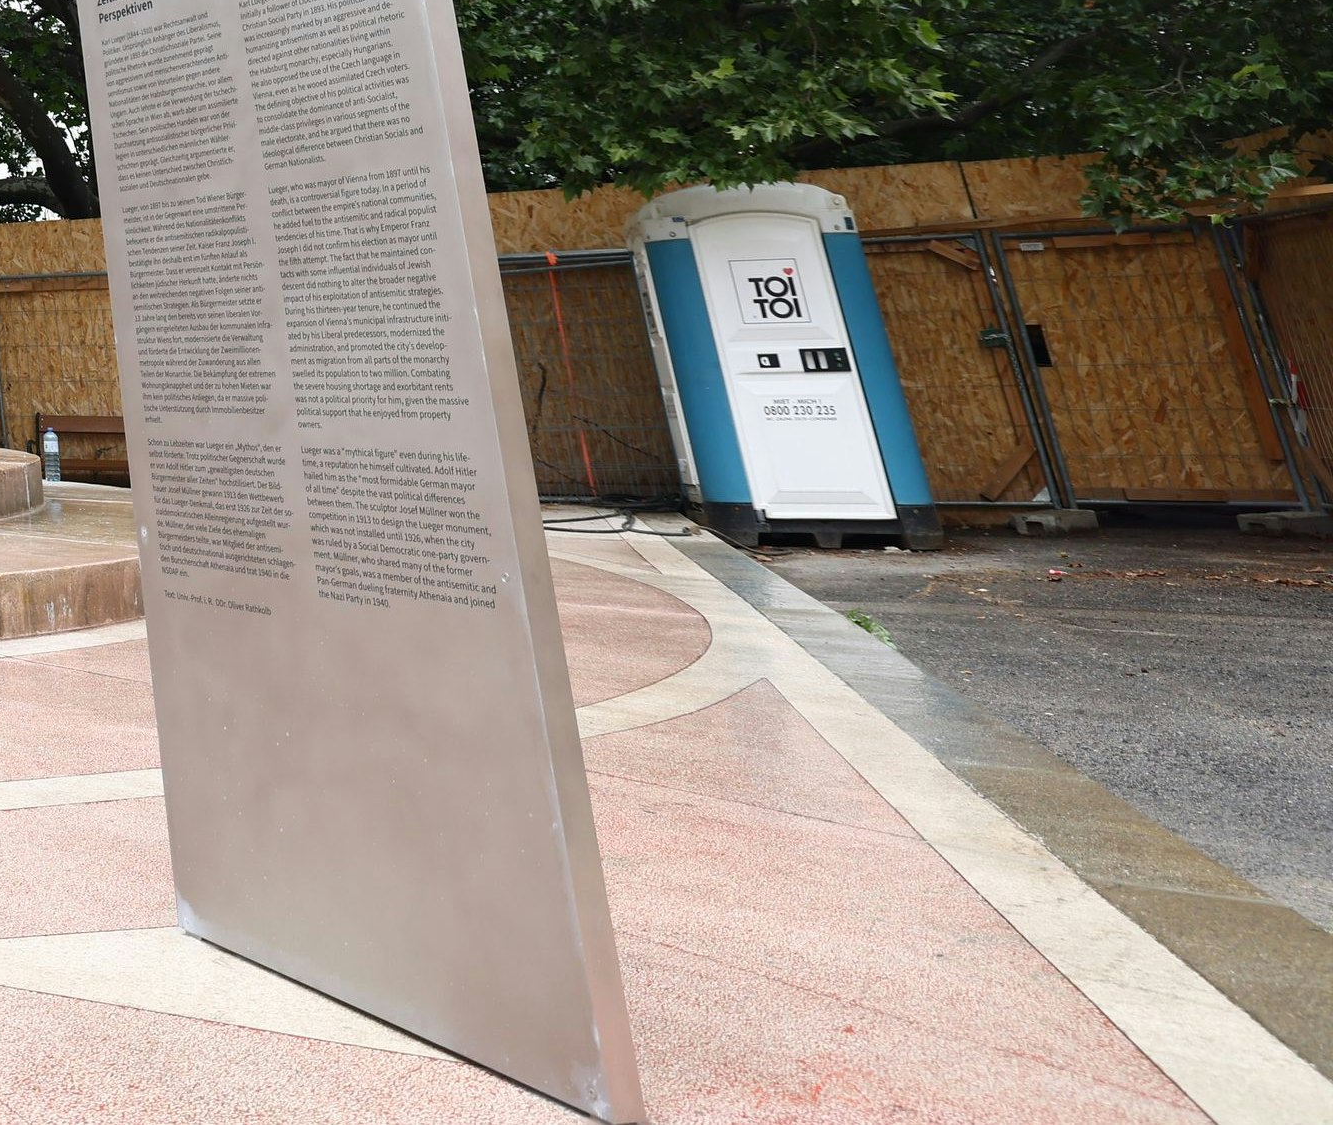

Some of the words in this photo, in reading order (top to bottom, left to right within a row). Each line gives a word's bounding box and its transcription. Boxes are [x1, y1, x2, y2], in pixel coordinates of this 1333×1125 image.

[98, 0, 154, 24] Perspektiven
[239, 0, 250, 8] Karl
[240, 9, 261, 20] Initially
[266, 2, 290, 13] follower
[242, 20, 267, 31] Christian
[267, 13, 286, 25] Social
[286, 11, 302, 20] Party
[302, 8, 310, 17] in
[327, 0, 338, 10] His
[264, 160, 288, 171] German
[753, 297, 802, 319] TOI
[764, 405, 790, 416] 0800
[794, 405, 813, 416] 230
[816, 405, 836, 416] 235
[301, 446, 322, 455] Lueger
[417, 451, 443, 462] during
[443, 451, 455, 462] his
[325, 461, 359, 470] reputation
[359, 461, 368, 470] he
[369, 462, 394, 472] himself
[434, 465, 454, 475] Adolf
[455, 467, 477, 477] Hitler
[304, 471, 323, 480] hailed
[324, 472, 337, 481] him
[346, 474, 357, 483] the
[380, 475, 418, 487] formidable
[420, 478, 450, 489] German
[451, 480, 475, 492] mayor
[306, 484, 312, 493] of
[313, 485, 321, 493] all
[341, 486, 365, 497] despite
[366, 488, 378, 498] the
[378, 491, 393, 500] vast
[394, 490, 423, 501] political
[424, 492, 465, 505] differences
[307, 497, 335, 507] between
[355, 500, 368, 511] The
[370, 502, 397, 513] sculptor
[399, 505, 418, 515] Josef
[419, 506, 447, 517] Müllner
[448, 511, 466, 519] won
[467, 510, 480, 520] the
[309, 512, 347, 522] competition
[348, 513, 355, 523] in
[356, 515, 371, 524] 1913
[372, 516, 380, 525] to
[381, 517, 405, 528] design
[405, 519, 418, 529] the
[419, 521, 444, 532] Lueger
[310, 524, 329, 533] which
[330, 527, 343, 535] was
[344, 525, 356, 536] not
[355, 527, 385, 539] installed
[386, 531, 403, 541] until
[424, 535, 445, 545] when
[446, 536, 459, 547] the
[461, 538, 475, 549] city
[312, 538, 325, 546] was
[326, 538, 342, 548] ruled
[343, 539, 352, 550] by
[358, 541, 379, 552] Social
[380, 544, 421, 557] Democratic
[422, 550, 459, 562] one-party
[361, 555, 376, 565] who
[377, 557, 401, 568] shared
[402, 562, 422, 572] many
[423, 562, 431, 572] of
[432, 563, 445, 574] the
[446, 564, 473, 577] former
[317, 576, 357, 590] Pan-German
[358, 581, 384, 595] dueling
[385, 584, 418, 599] fraternity
[419, 590, 452, 603] Athenaia
[454, 595, 469, 605] and
[470, 596, 495, 609] joined
[362, 571, 376, 579] was
[383, 573, 412, 584] member
[414, 575, 421, 585] of
[422, 575, 435, 587] the
[437, 579, 480, 593] antisemitic
[481, 585, 497, 594] and
[319, 589, 330, 598] the
[330, 591, 345, 601] Nazi
[346, 593, 363, 605] Party
[364, 596, 371, 605] in
